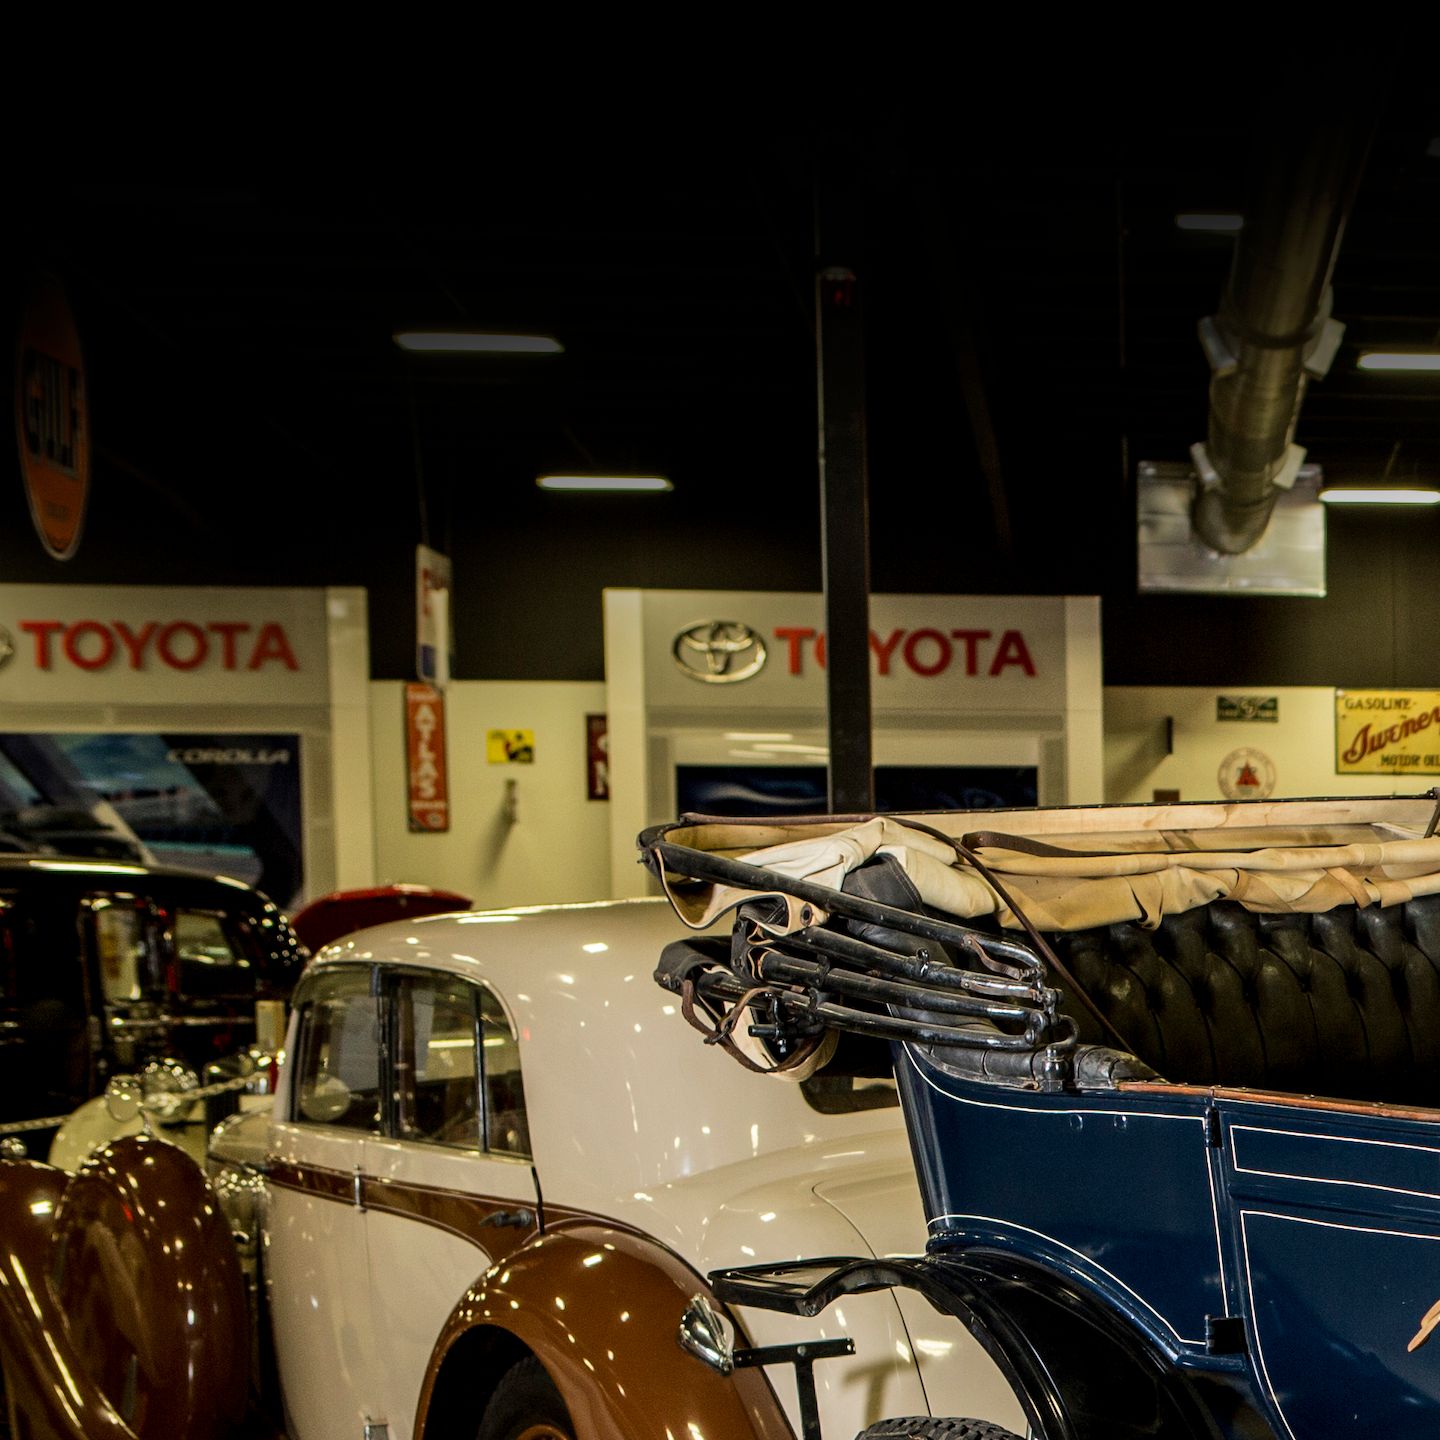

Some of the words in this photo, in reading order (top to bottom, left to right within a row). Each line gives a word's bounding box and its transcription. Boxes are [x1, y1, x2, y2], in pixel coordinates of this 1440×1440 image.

[19, 621, 299, 671] TOYOTA
[1345, 697, 1412, 711] GASOLINE
[414, 704, 437, 799] ATLAS
[1379, 754, 1420, 767] MOTOR
